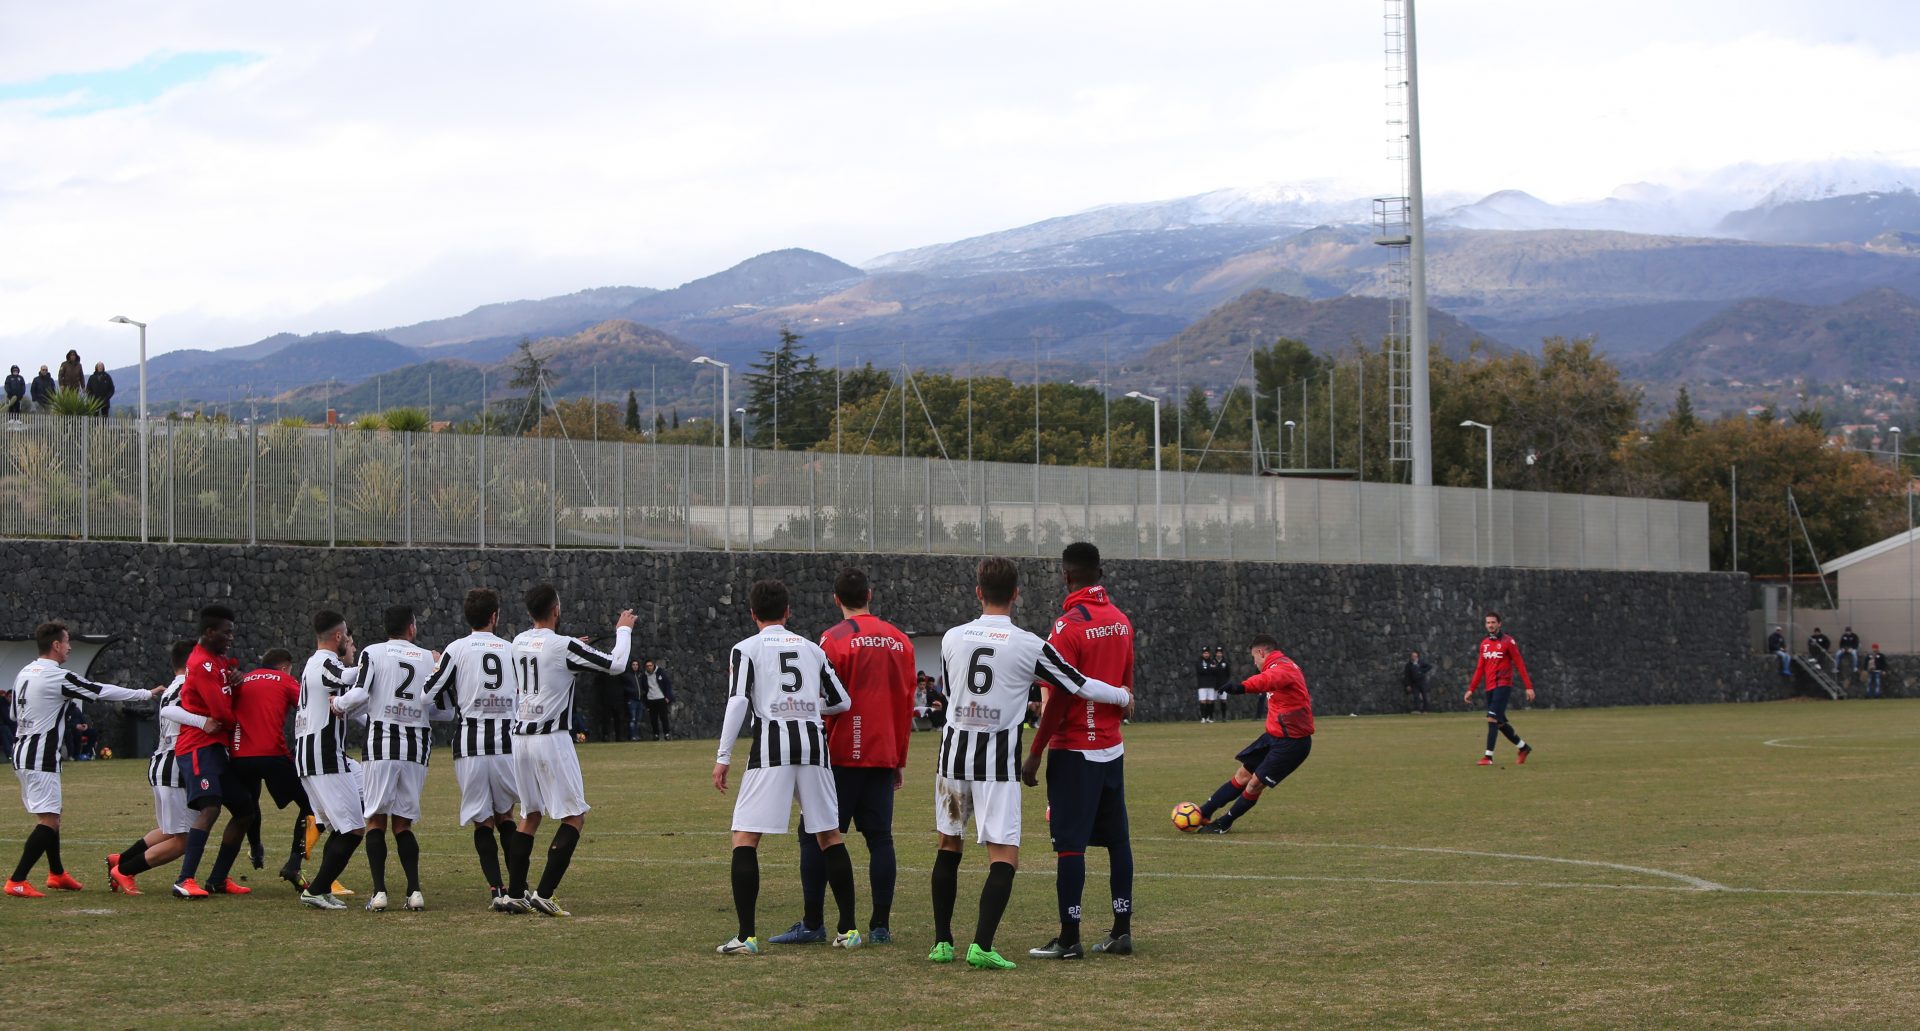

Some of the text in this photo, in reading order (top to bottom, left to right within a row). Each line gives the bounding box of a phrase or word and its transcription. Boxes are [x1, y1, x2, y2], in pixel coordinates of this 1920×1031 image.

[1085, 622, 1129, 640] macron
[850, 636, 904, 653] macron
[243, 673, 281, 682] acron
[482, 652, 504, 690] 9
[519, 655, 540, 695] 11
[778, 651, 803, 693] 5
[967, 646, 995, 695] 6
[394, 661, 415, 700] 2
[17, 679, 28, 709] 4
[474, 693, 513, 708] saitta
[384, 702, 422, 718] saitta
[519, 699, 545, 715] aitta
[770, 696, 816, 714] saitta
[955, 701, 1001, 720] saitta
[852, 715, 862, 760] BOLOGNA FC
[1087, 731, 1096, 741] FC
[1112, 897, 1129, 909] BFC
